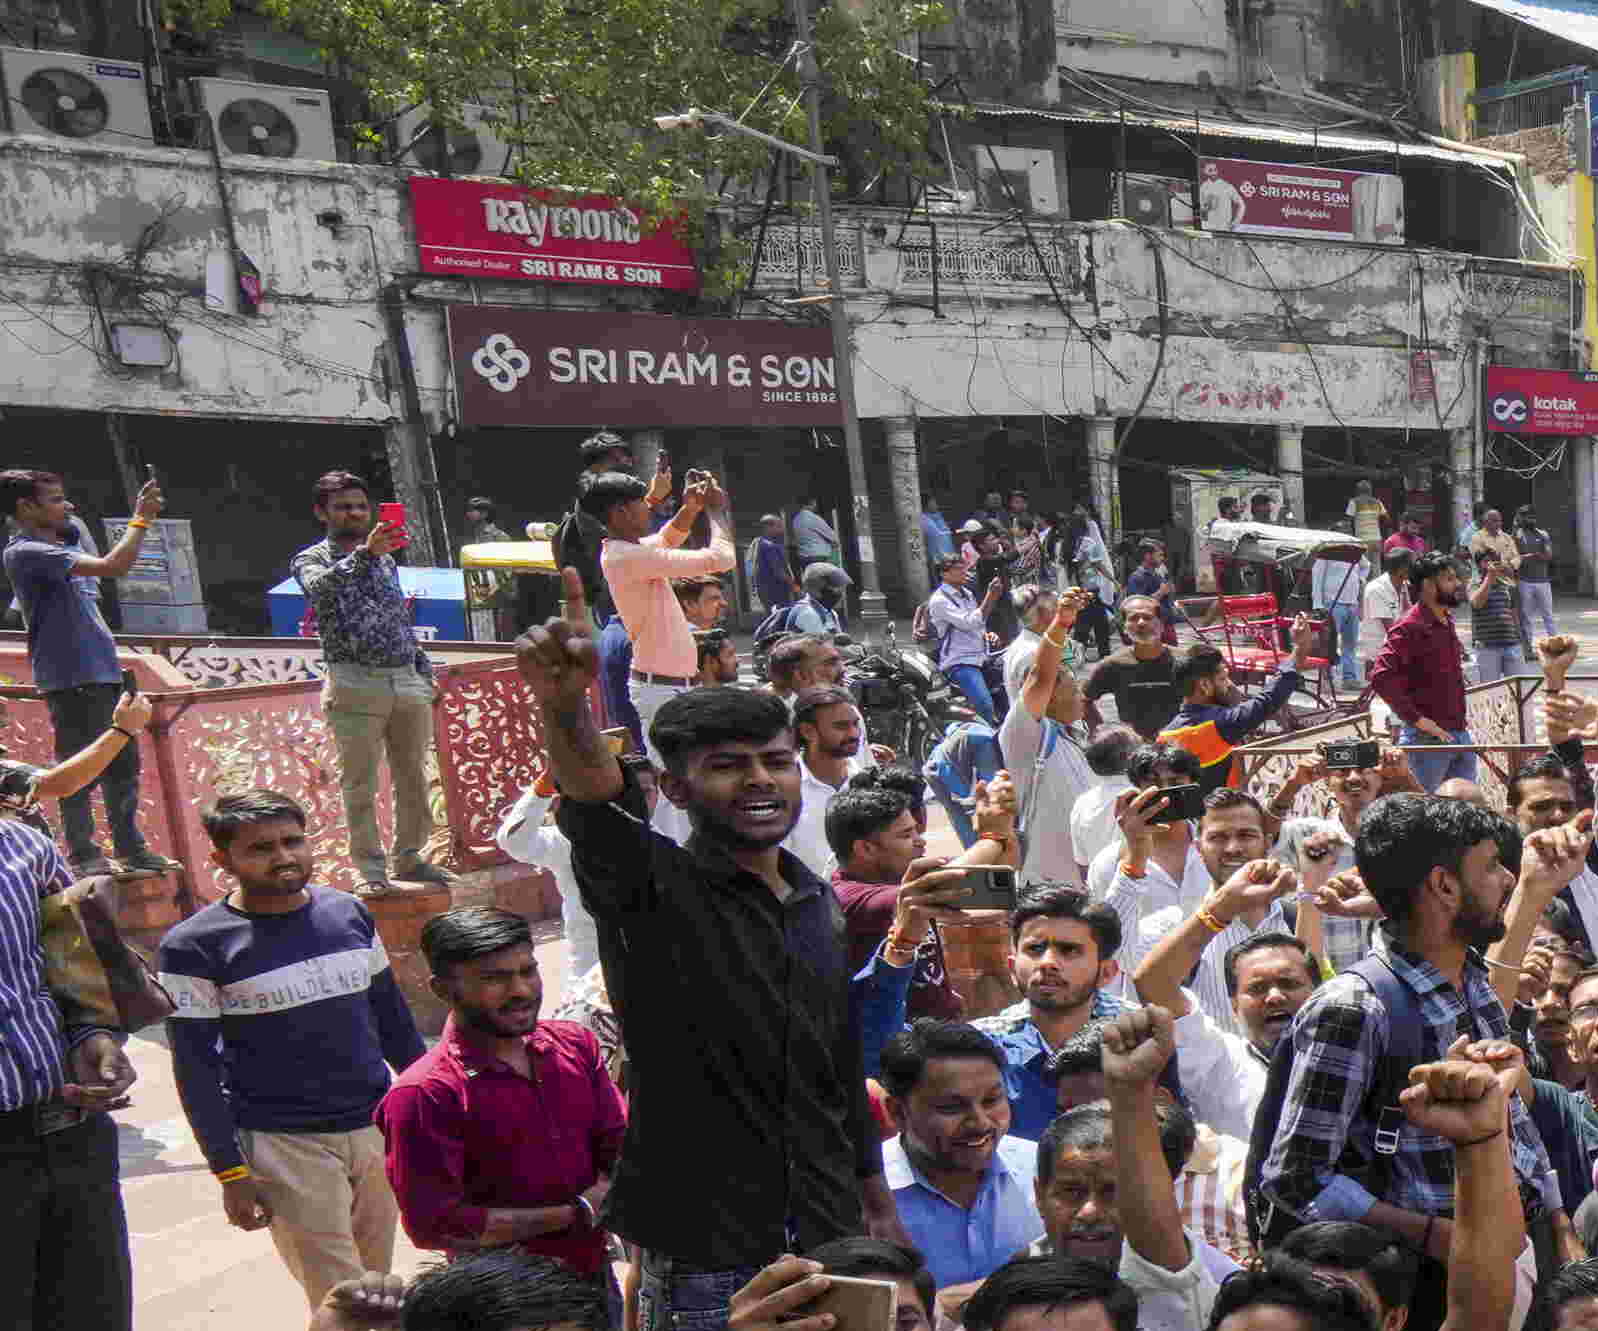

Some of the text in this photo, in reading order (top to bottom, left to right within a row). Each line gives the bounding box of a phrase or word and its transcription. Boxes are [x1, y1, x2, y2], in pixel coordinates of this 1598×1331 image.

[1260, 185, 1350, 203] SRI RAM & SON
[521, 259, 555, 277] SRI
[558, 263, 602, 281] RAM
[605, 264, 618, 281] &
[623, 266, 662, 284] SON
[548, 347, 836, 389] SRI RAM & SON
[762, 392, 802, 403] SINCE
[1533, 396, 1577, 411] kotak
